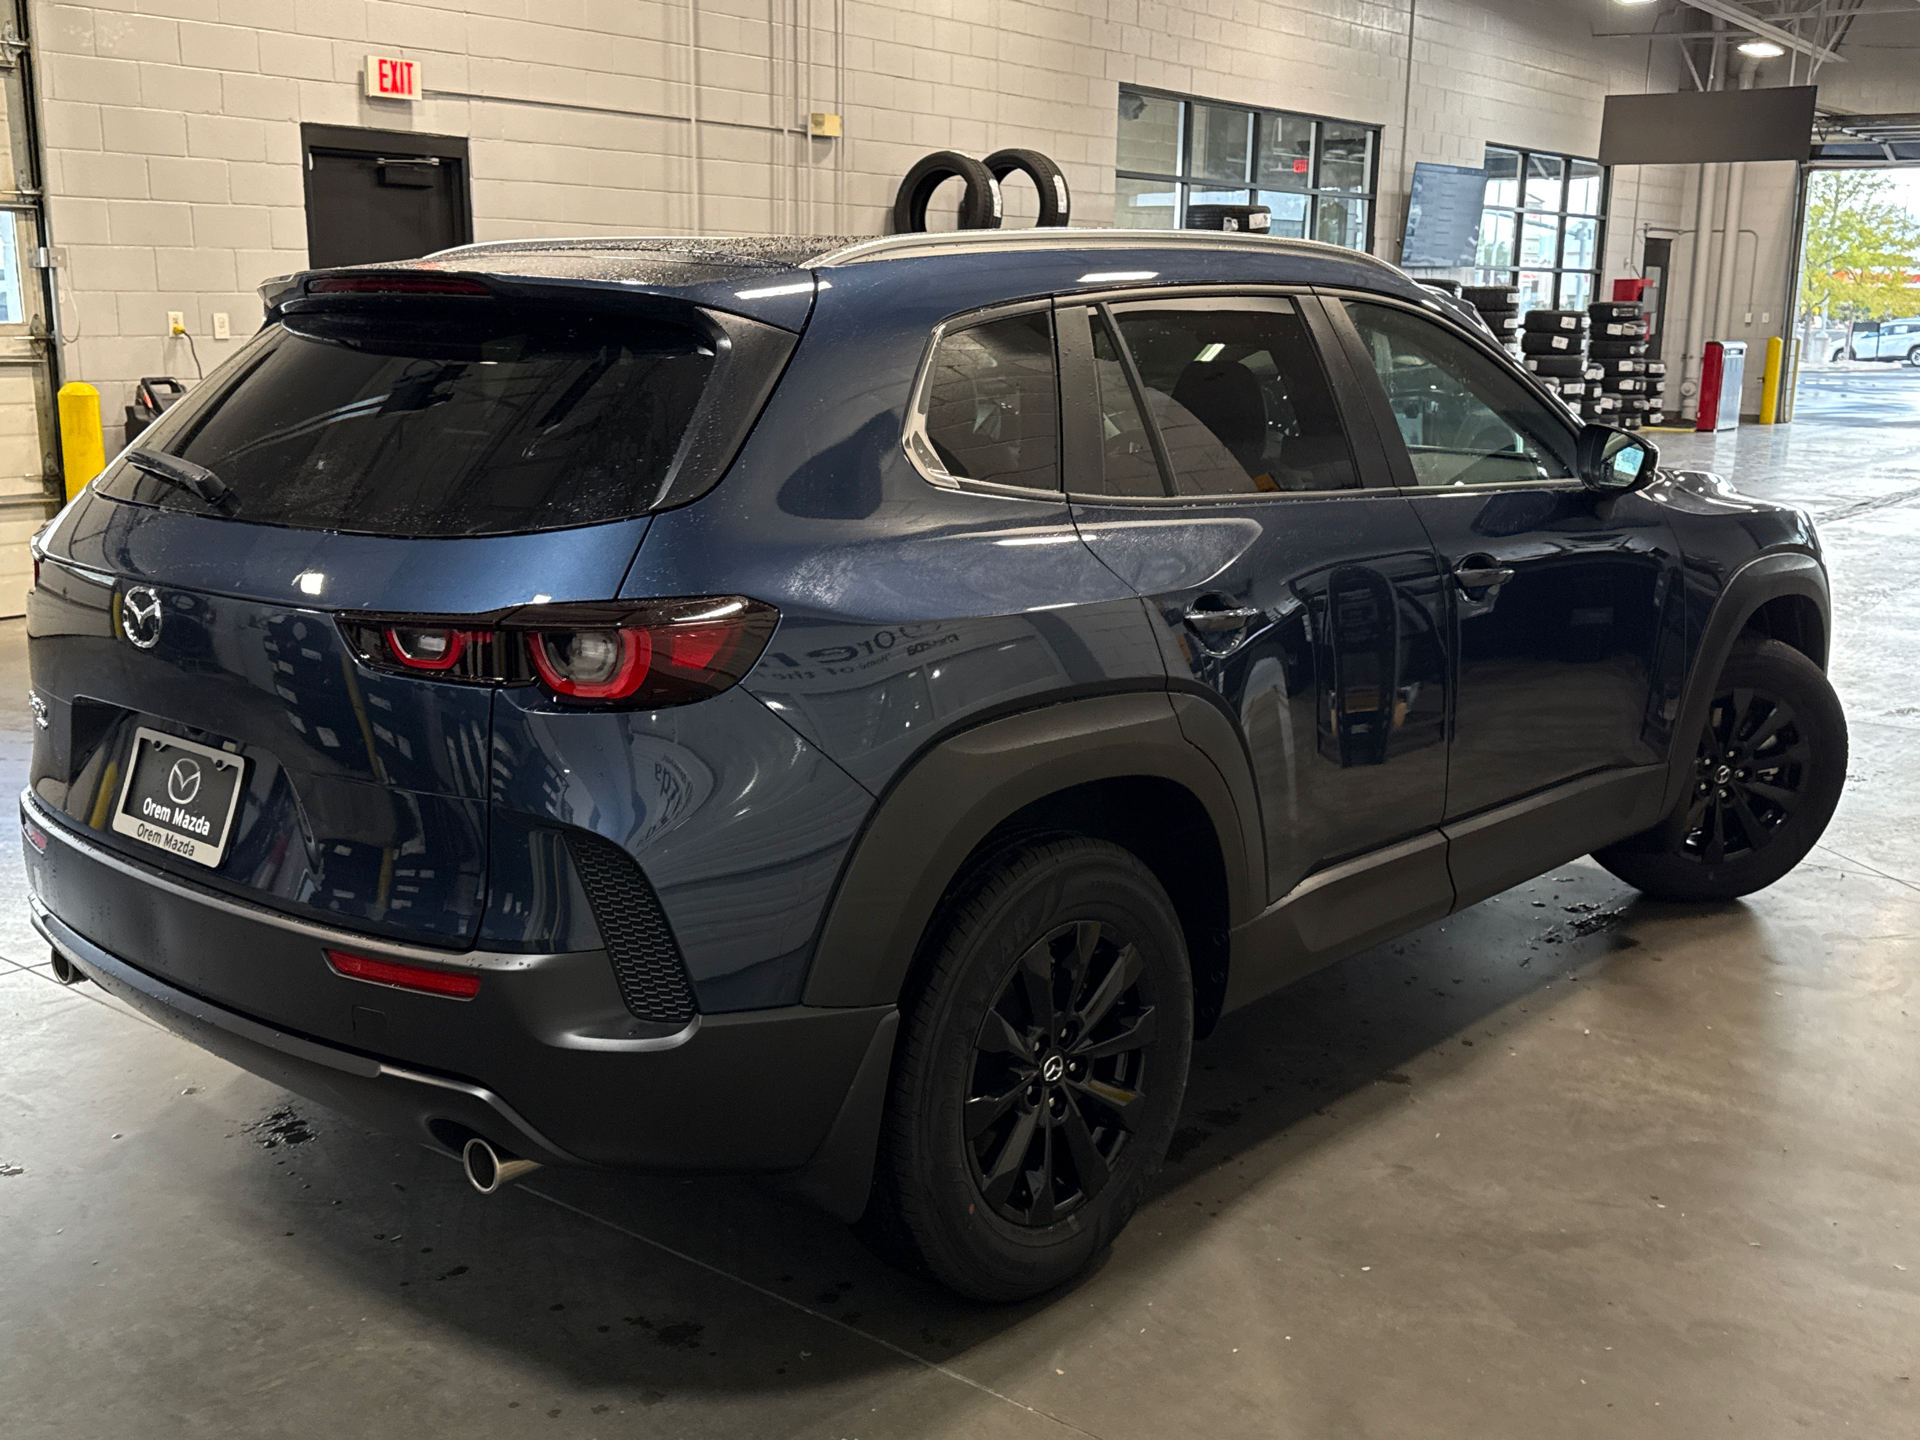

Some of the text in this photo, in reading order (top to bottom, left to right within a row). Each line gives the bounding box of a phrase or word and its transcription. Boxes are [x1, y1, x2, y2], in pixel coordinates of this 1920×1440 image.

[378, 59, 413, 95] EXIT
[143, 797, 210, 836] Orem Mazda
[137, 823, 195, 856] Orem Mazda
